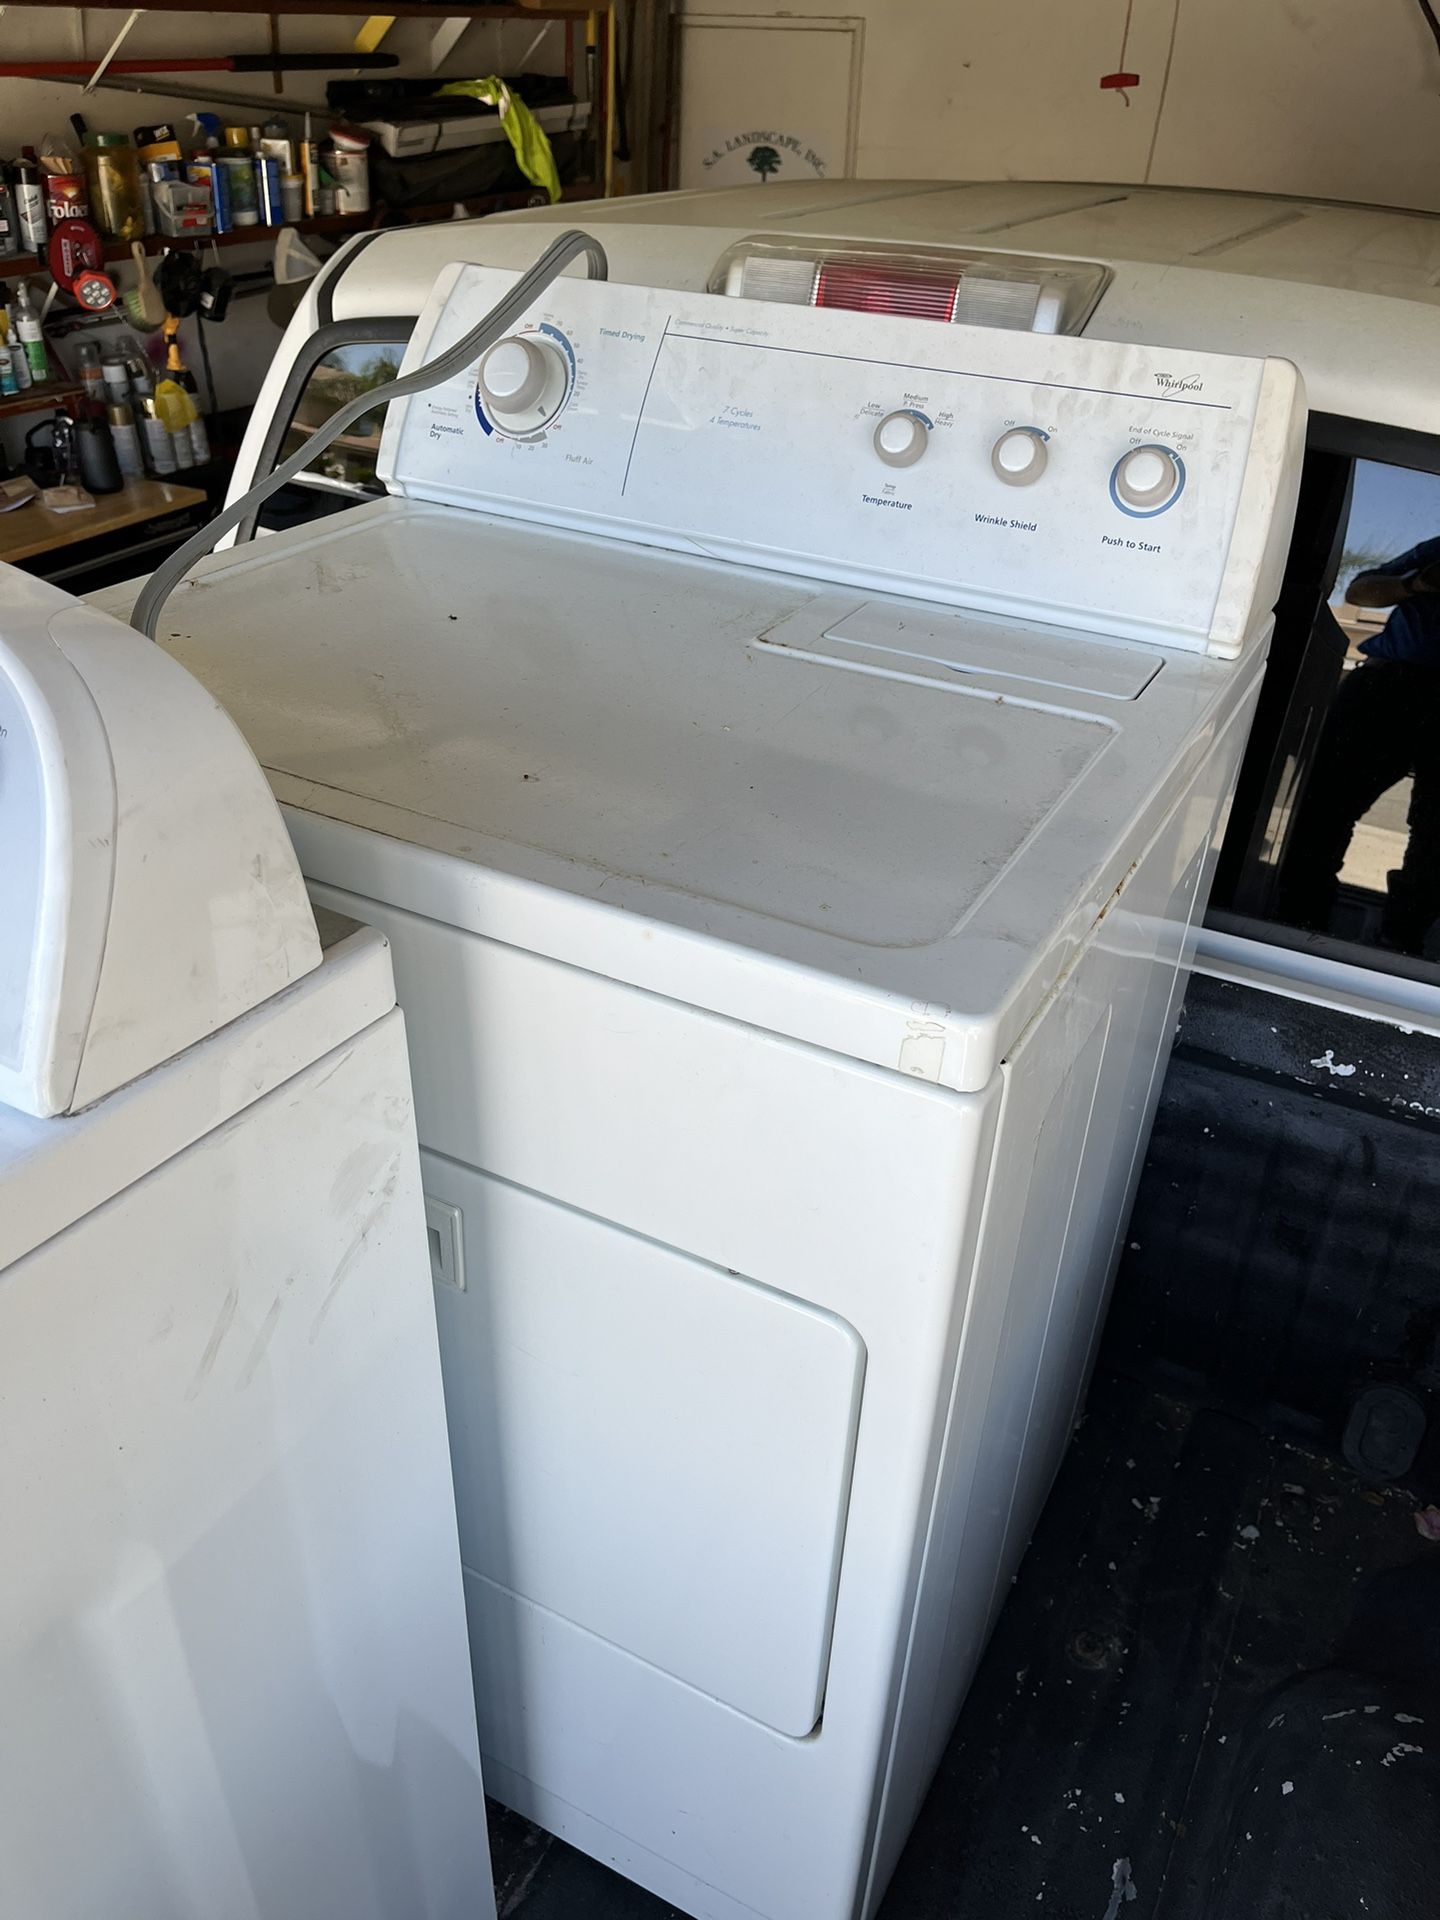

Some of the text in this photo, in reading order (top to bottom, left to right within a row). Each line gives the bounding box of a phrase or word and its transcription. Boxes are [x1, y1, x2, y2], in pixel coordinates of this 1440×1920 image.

[599, 328, 646, 342] Timed Drying
[1156, 377, 1203, 392] Whirlpool
[903, 392, 929, 402] Medium
[867, 401, 881, 409] Low
[722, 406, 753, 419] 7 Cycles
[860, 408, 885, 418] Delicate
[938, 411, 954, 420] High
[431, 423, 464, 436] Automatic
[709, 416, 761, 431] 4 Temperatures
[935, 418, 954, 429] Heavy
[429, 431, 441, 440] Dry
[1128, 425, 1143, 434] End
[1152, 429, 1171, 439] Cycle
[1172, 432, 1194, 441] Signal
[565, 454, 594, 465] Fluff Air
[862, 494, 912, 511] Temperature
[974, 513, 1037, 532] Wrinkle Shield
[1101, 535, 1161, 553] Push to Start
